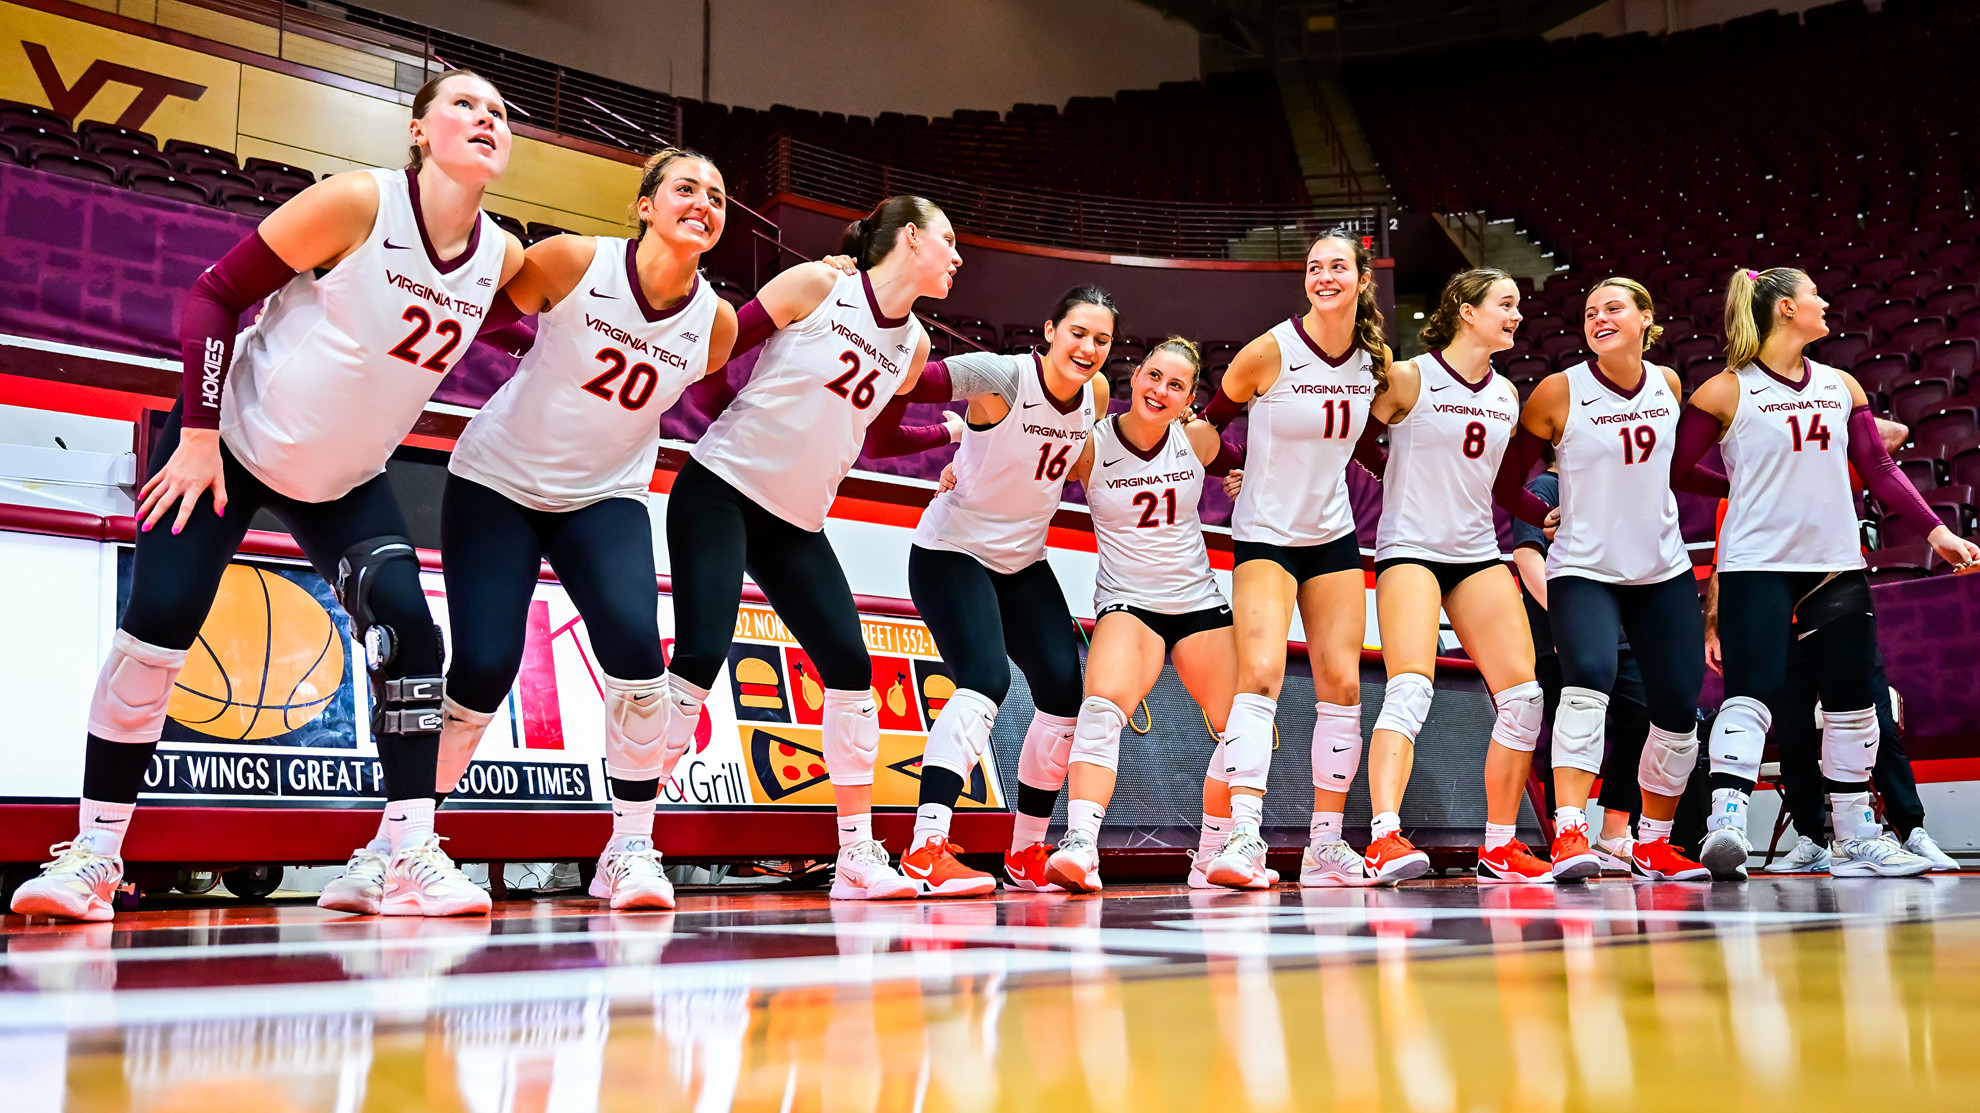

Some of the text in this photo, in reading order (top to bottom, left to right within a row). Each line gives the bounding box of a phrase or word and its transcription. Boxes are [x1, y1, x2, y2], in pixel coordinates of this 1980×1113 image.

[386, 269, 483, 319] VIRGINIA TECH
[387, 304, 463, 373] 22
[585, 312, 688, 371] VIRGINIA TECH
[680, 331, 699, 343] ACC
[831, 319, 900, 378] VIRGINIA TECH
[202, 336, 225, 408] HOKIES
[581, 346, 659, 411] 20
[823, 349, 882, 410] 26
[1291, 384, 1371, 394] VIRGINIA TECH
[1322, 399, 1351, 440] 11
[1432, 403, 1512, 423] VIRGINIA TECH
[1590, 408, 1670, 426] VIRGINIA TECH
[1758, 399, 1842, 413] VIRGINIA TECH
[1022, 422, 1068, 439] VIRGINIA
[1462, 420, 1487, 460] 8
[1617, 424, 1657, 466] 19
[1785, 412, 1831, 452] 14
[1034, 442, 1073, 482] 16
[1106, 469, 1195, 489] VIRGINIA TECH
[1132, 487, 1177, 529] 21
[754, 612, 794, 641] NOR
[861, 622, 893, 651] REET
[902, 627, 940, 656] 552-1
[143, 754, 180, 787] OT
[187, 755, 270, 790] WINGS
[288, 759, 366, 792] GREAT
[455, 764, 519, 795] GOOD
[523, 766, 586, 796] TIMES
[689, 760, 747, 804] Grill
